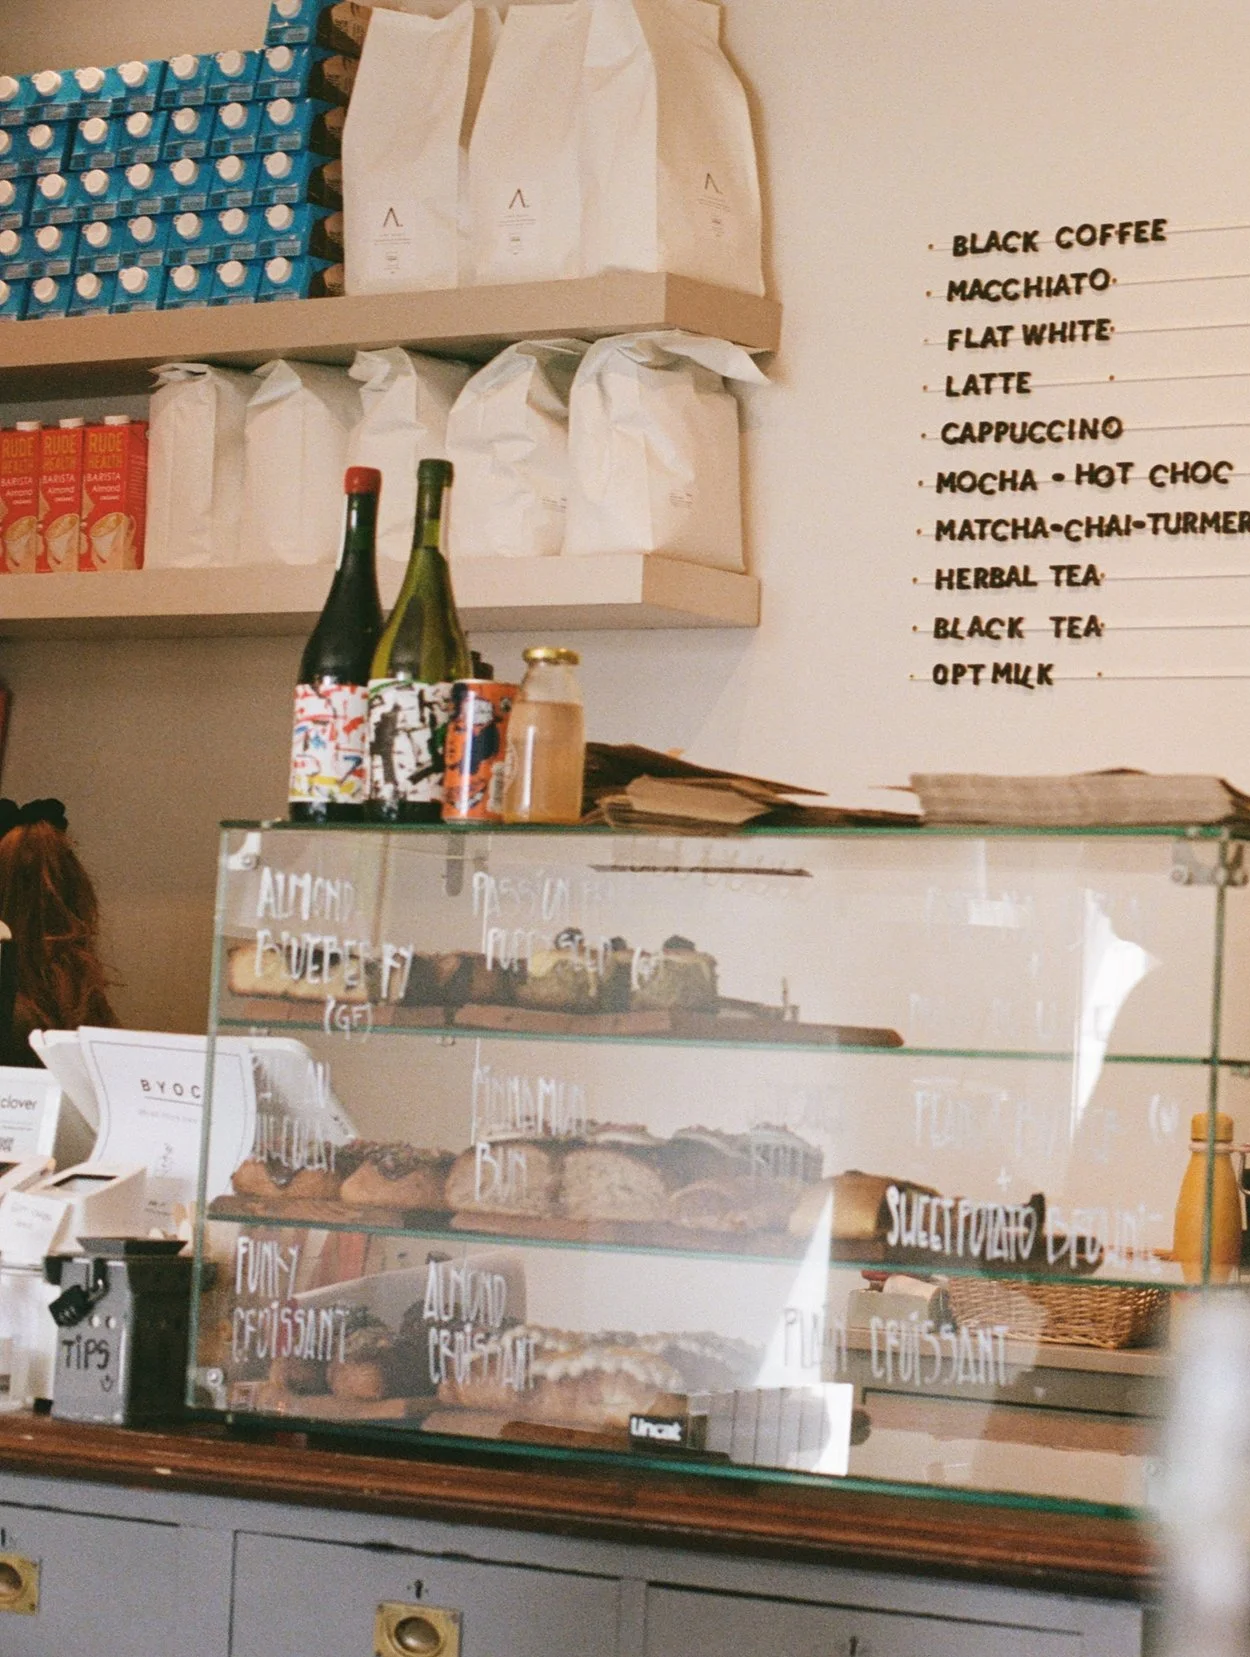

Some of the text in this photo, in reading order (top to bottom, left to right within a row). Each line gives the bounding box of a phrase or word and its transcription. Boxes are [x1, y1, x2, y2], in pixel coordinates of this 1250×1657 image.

[952, 230, 1040, 258] BLACK
[1055, 218, 1167, 250] COFFEE
[946, 267, 1111, 303] MACCHIATO
[947, 325, 1015, 352] FLAT
[1022, 318, 1111, 346] WHITE
[945, 371, 1032, 398] LATTE
[88, 431, 125, 453] RUDE
[941, 415, 1124, 446] CAPPUCCINO
[43, 434, 77, 455] RUDE
[85, 472, 121, 482] BARISTA
[935, 468, 1038, 496] MOCHA
[1074, 461, 1134, 489] HOT
[1148, 460, 1234, 488] CHOC
[935, 565, 1038, 591] HERBAL
[1049, 563, 1102, 587] TEA
[933, 615, 1024, 641] BLACK
[1049, 614, 1102, 639] TEA
[932, 663, 986, 686] OPT
[991, 662, 1055, 690] MILK
[0, 1094, 37, 1110] clover
[140, 1078, 202, 1100] BYOC
